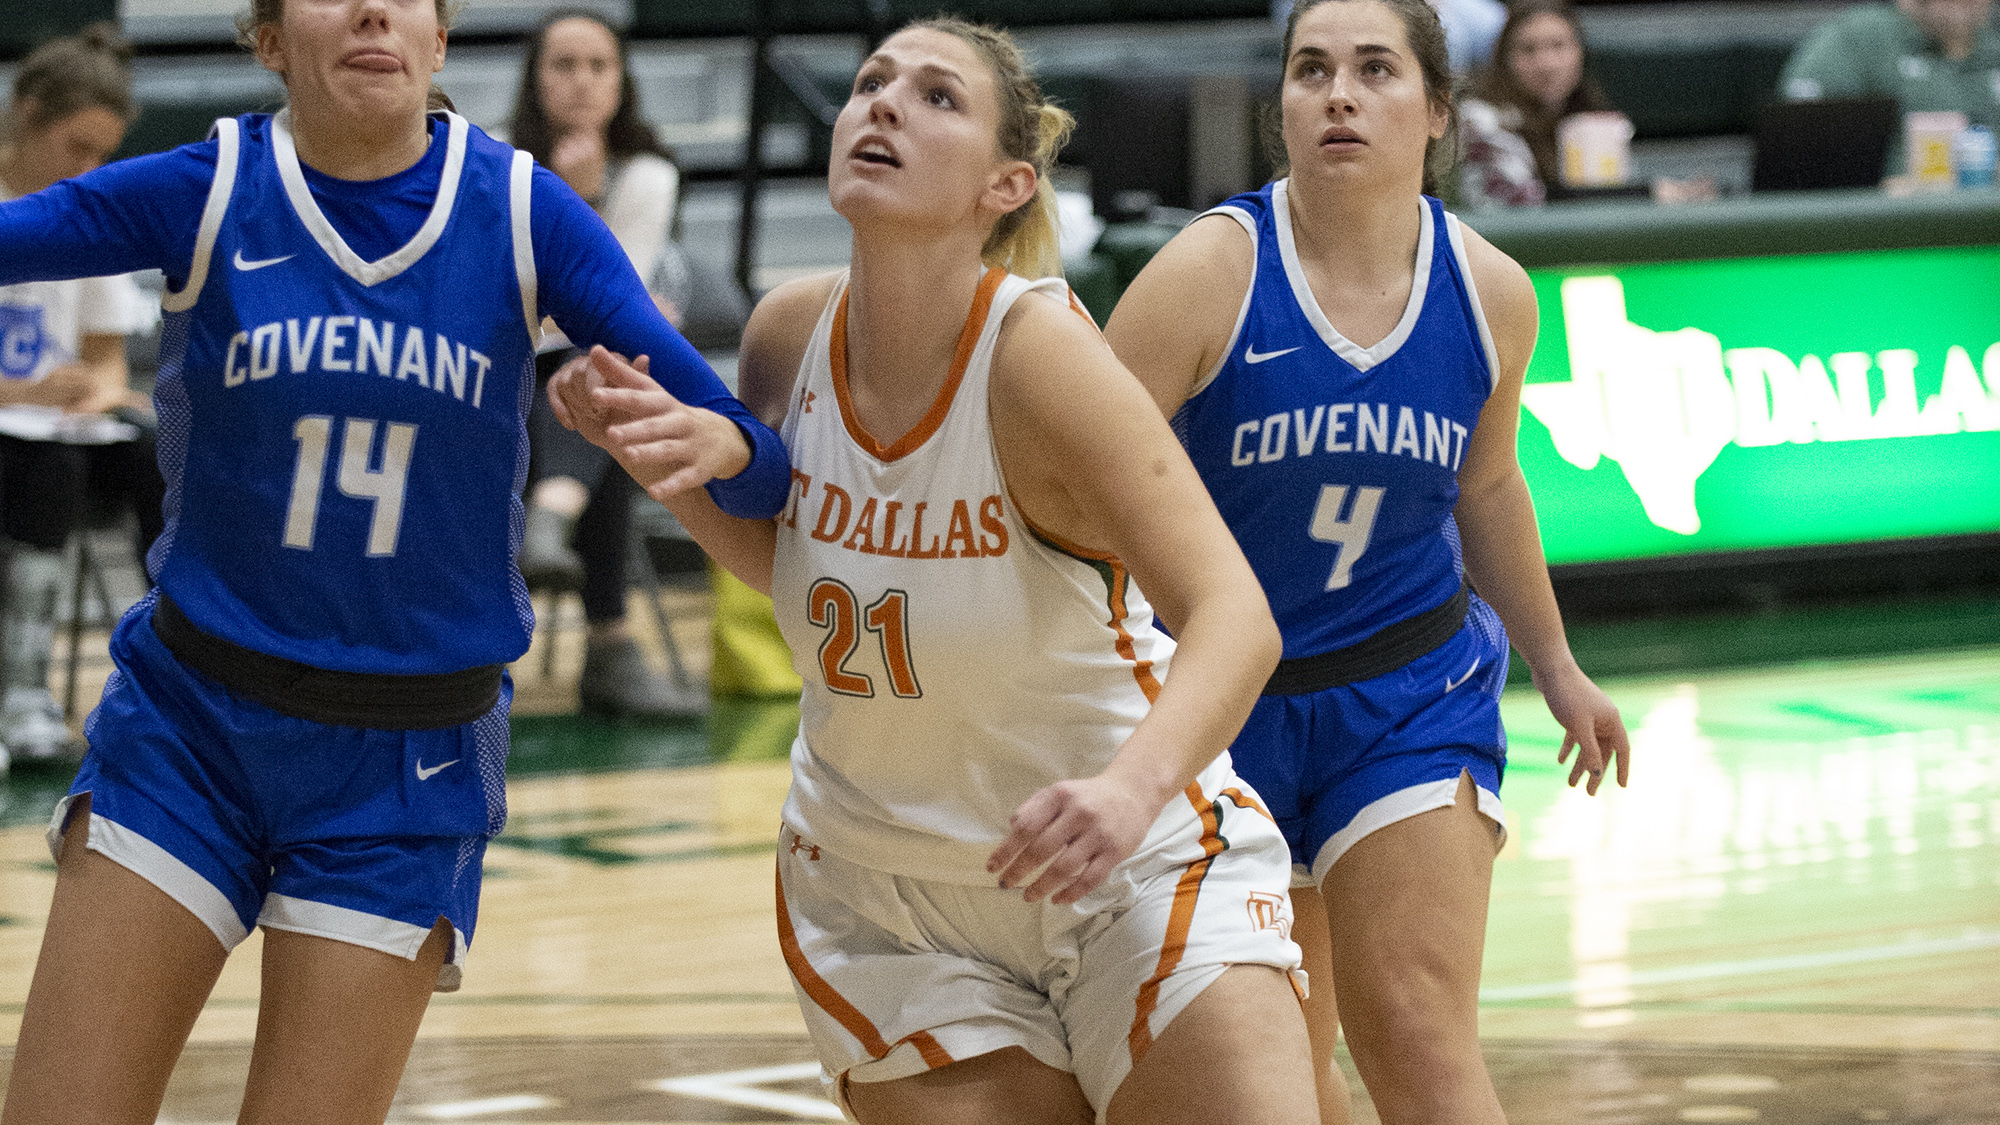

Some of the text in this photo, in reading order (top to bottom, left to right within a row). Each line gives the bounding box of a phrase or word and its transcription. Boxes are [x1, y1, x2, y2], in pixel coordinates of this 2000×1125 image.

[224, 315, 491, 409] COVENANT
[281, 413, 419, 557] 14
[1231, 402, 1467, 472] COVENANT
[811, 482, 1009, 559] DALLAS
[1308, 483, 1387, 592] 4
[807, 577, 923, 699] 21
